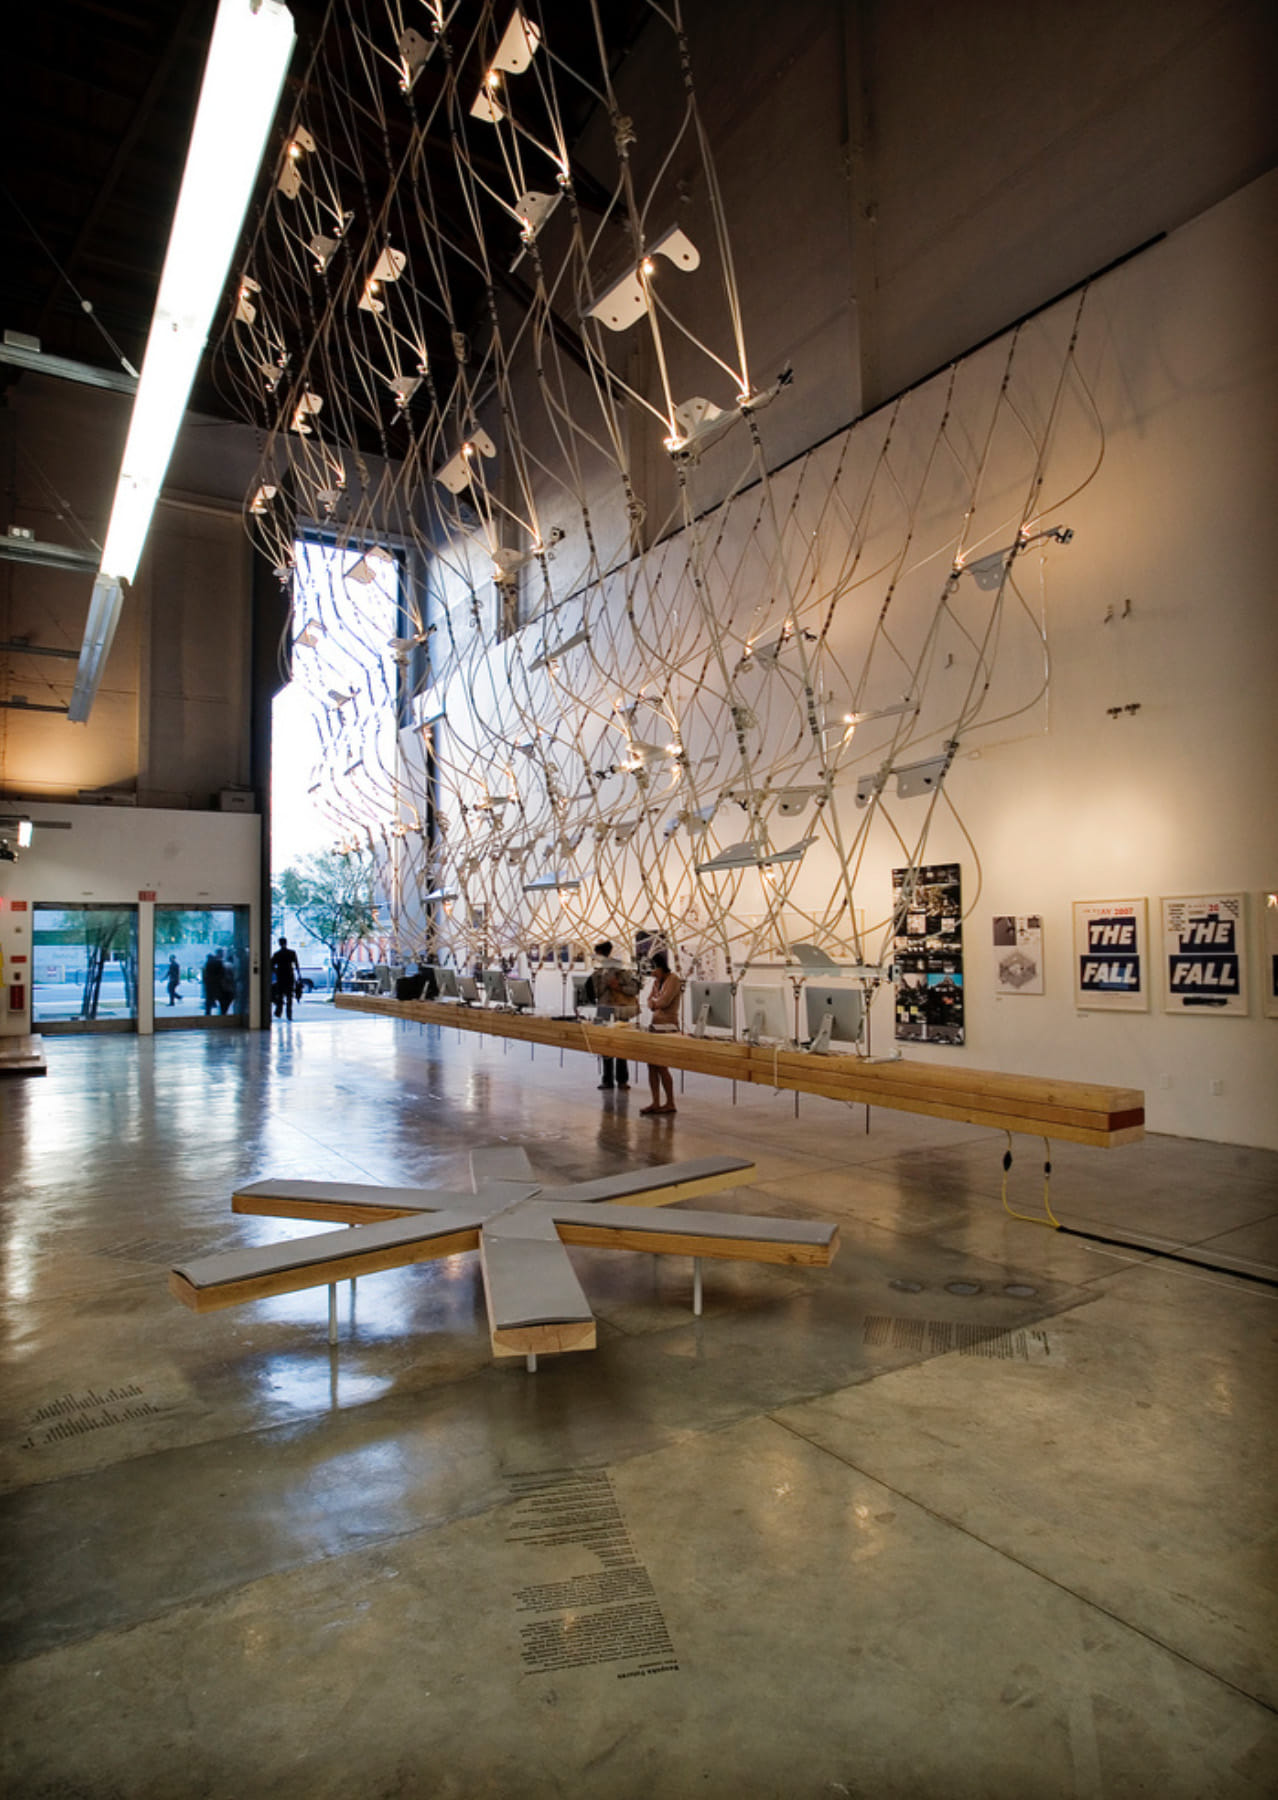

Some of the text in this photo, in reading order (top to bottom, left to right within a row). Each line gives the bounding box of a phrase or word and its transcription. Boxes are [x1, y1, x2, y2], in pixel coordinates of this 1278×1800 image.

[1089, 924, 1135, 945] THE
[1182, 921, 1232, 944] THE
[1083, 962, 1137, 984] FALL
[1173, 962, 1236, 986] FALL
